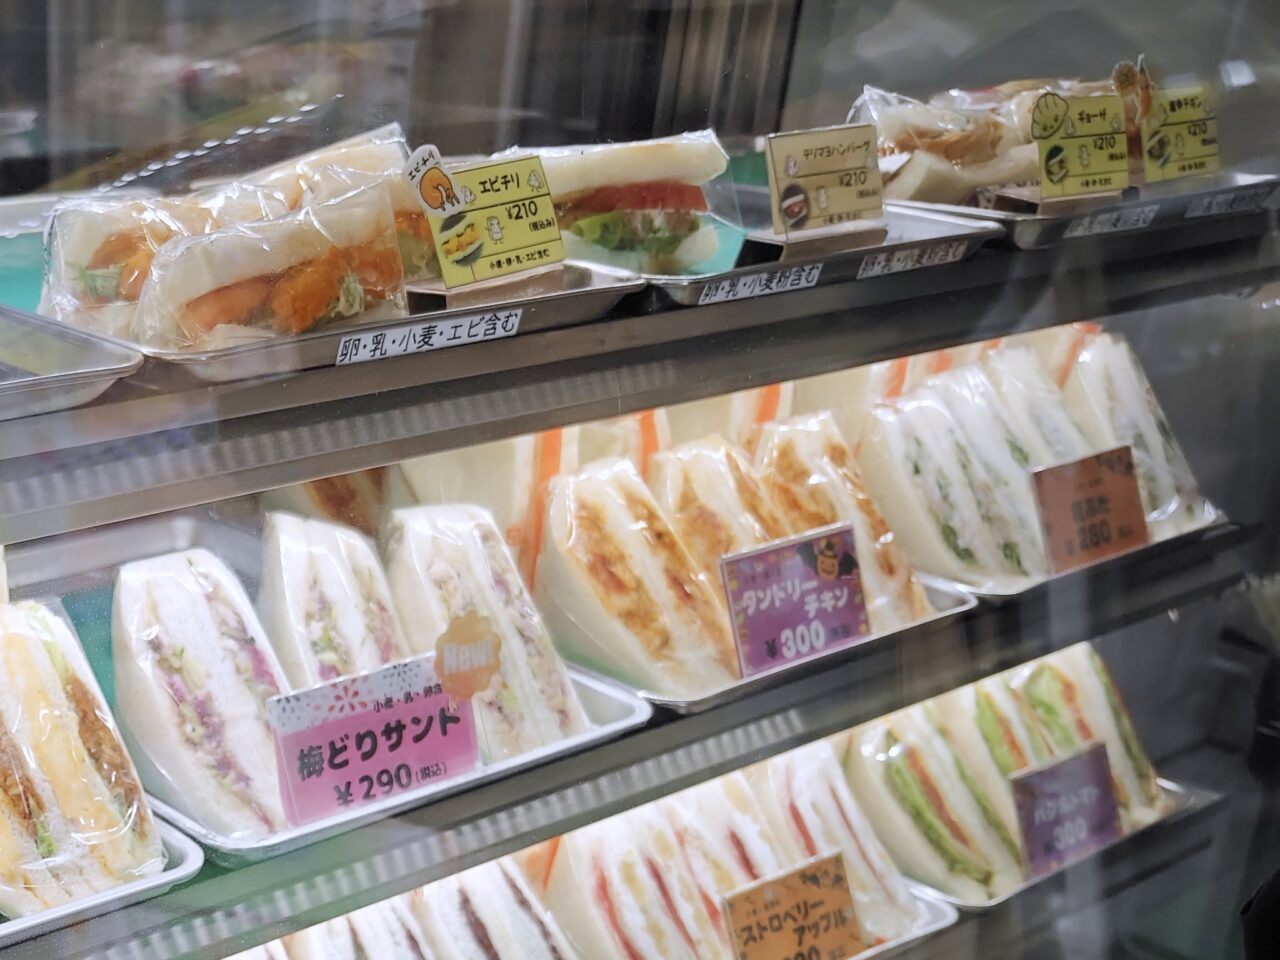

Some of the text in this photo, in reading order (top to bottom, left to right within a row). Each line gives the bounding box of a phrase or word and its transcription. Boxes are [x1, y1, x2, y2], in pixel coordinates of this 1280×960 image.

[478, 172, 520, 194] エビチリ
[505, 200, 538, 220] ¥210
[338, 312, 518, 363] 卵・乳・小麦・エビ含む
[804, 586, 849, 619] チキン
[333, 763, 413, 806] ¥290
